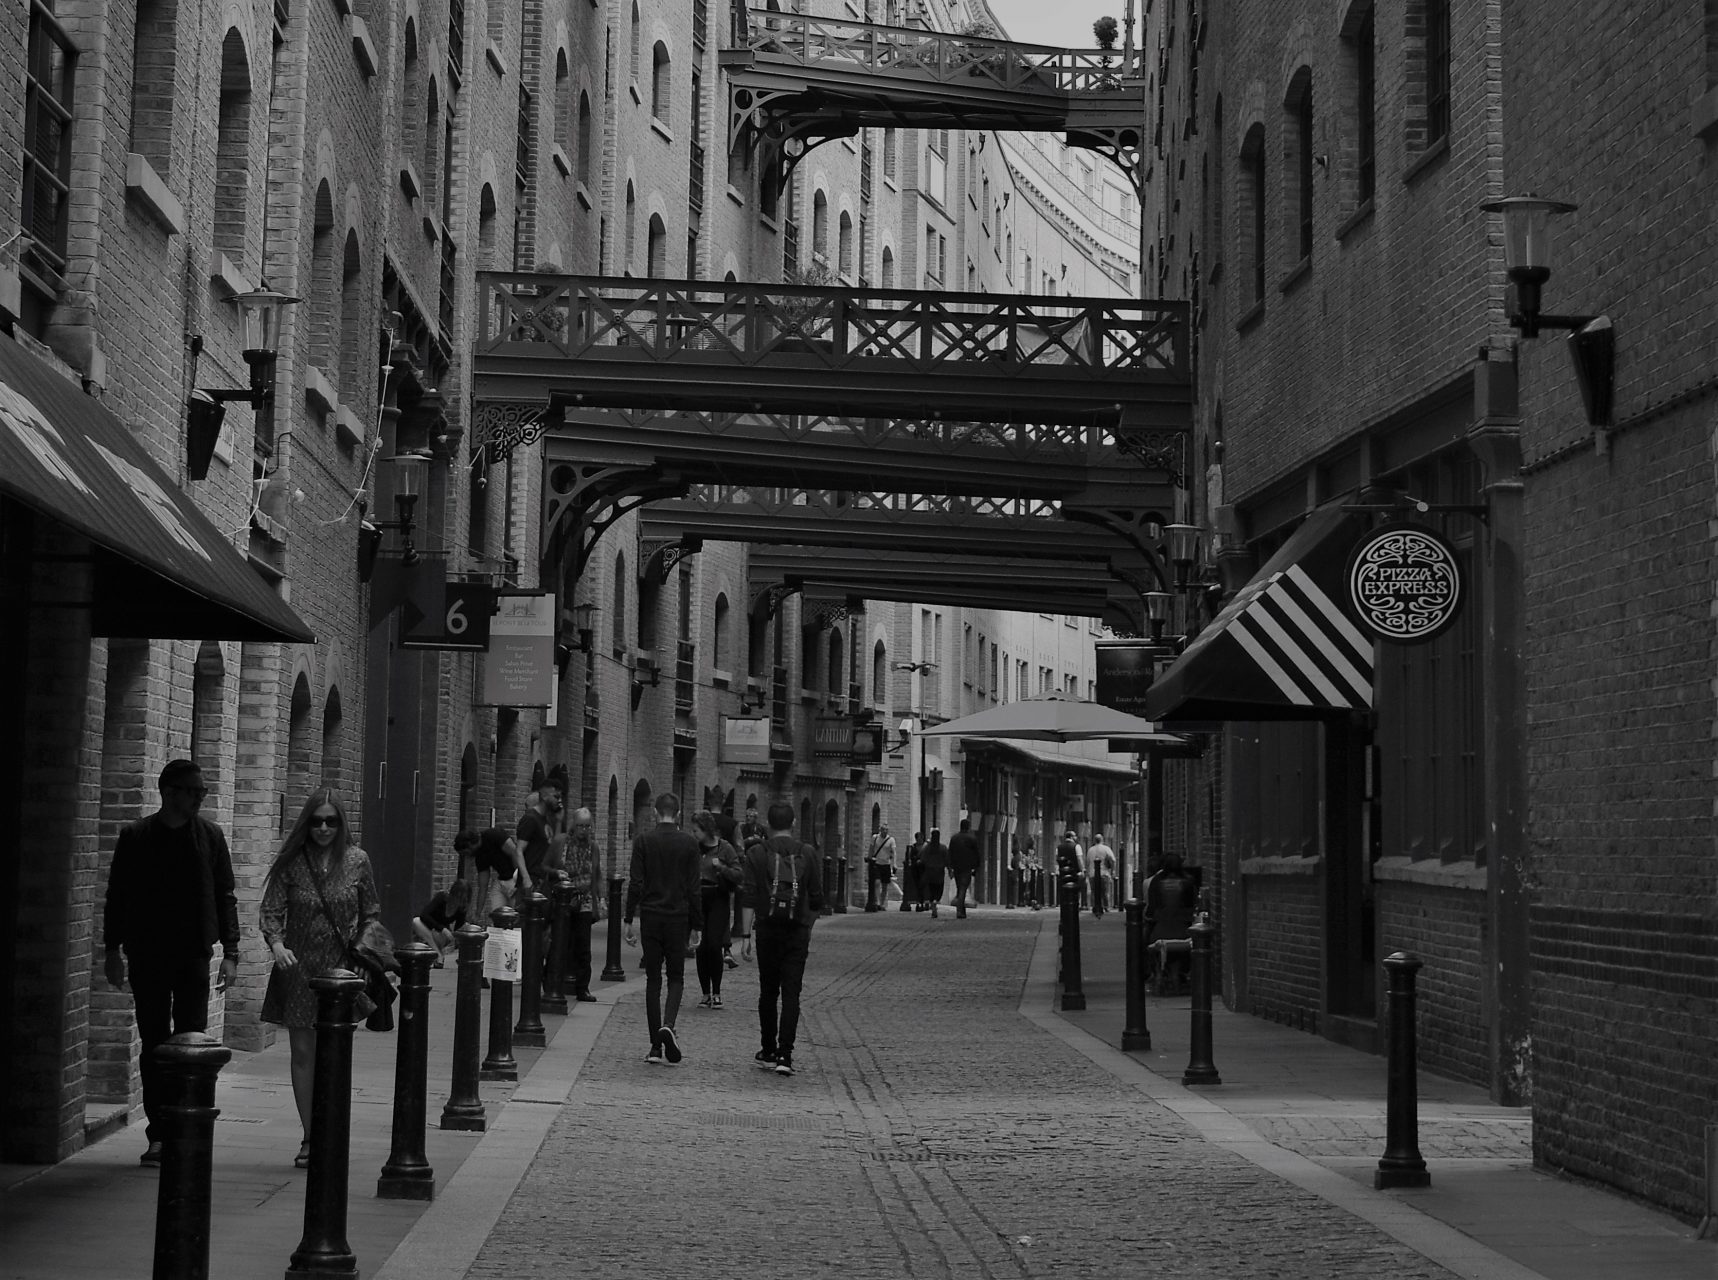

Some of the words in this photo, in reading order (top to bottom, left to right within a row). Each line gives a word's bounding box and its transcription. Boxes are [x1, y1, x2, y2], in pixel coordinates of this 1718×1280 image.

[1379, 567, 1432, 581] PIZZA
[1364, 581, 1448, 595] EXPRESS
[446, 598, 468, 634] 6
